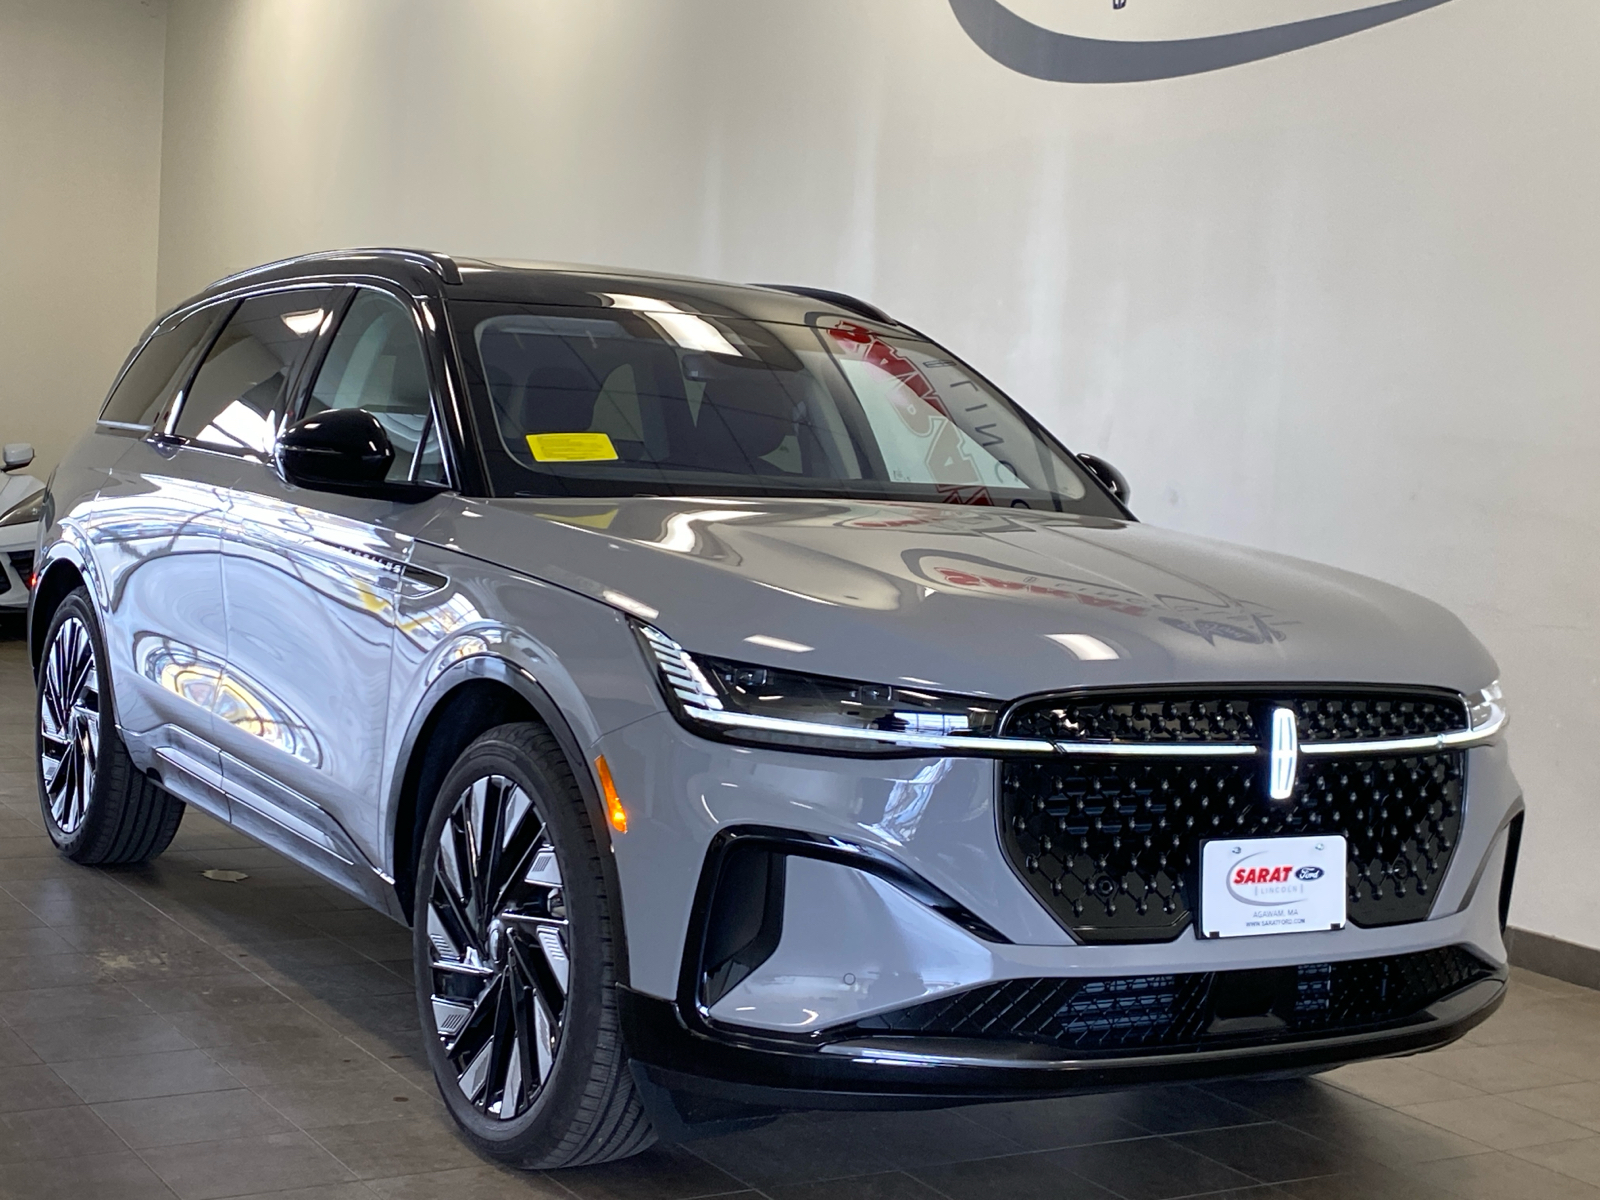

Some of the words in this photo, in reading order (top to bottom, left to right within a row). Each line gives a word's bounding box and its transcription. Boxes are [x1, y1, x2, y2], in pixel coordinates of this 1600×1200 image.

[1233, 866, 1293, 884] SARAT
[1298, 867, 1322, 880] Ford
[1260, 885, 1297, 894] LINCOLN
[1287, 908, 1298, 916] MA
